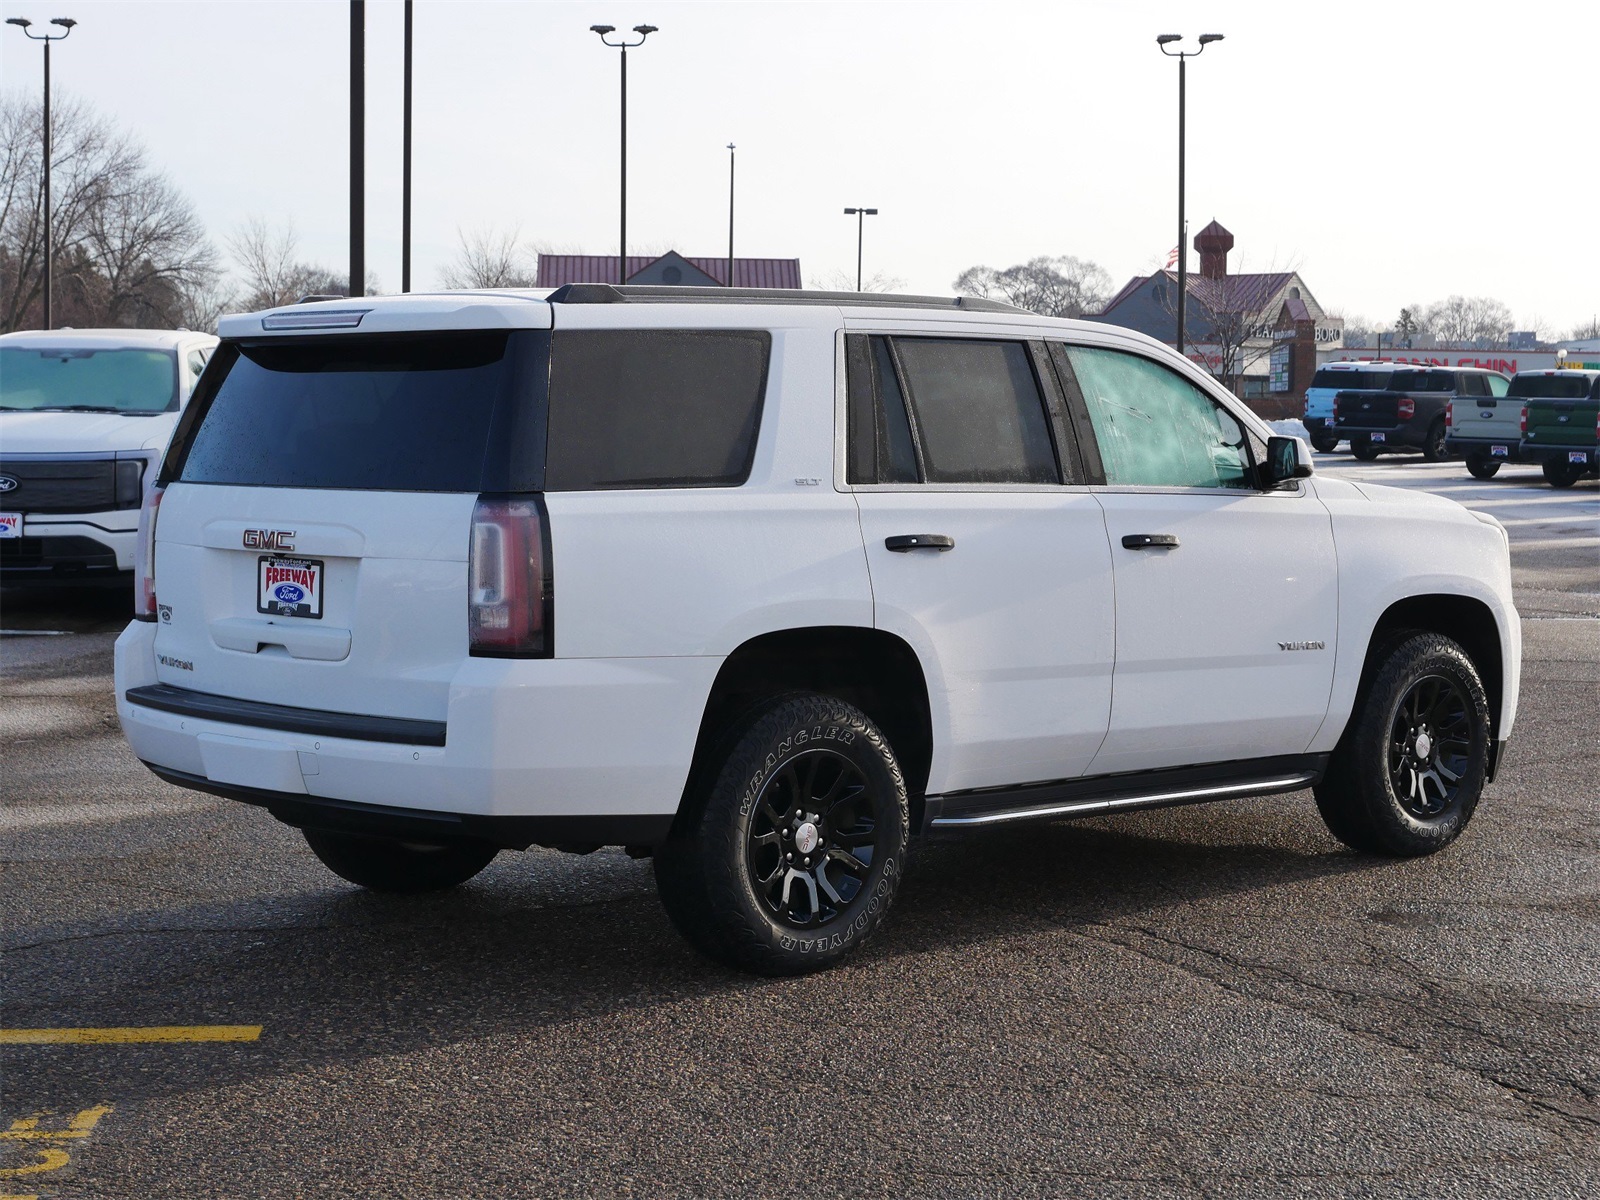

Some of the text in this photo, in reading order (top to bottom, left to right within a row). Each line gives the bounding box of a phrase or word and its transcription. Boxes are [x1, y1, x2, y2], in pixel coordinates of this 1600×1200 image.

[794, 478, 823, 486] SLT
[243, 529, 296, 551] GMC
[265, 566, 316, 597] FREEWAY
[280, 586, 300, 601] Ford
[1277, 640, 1326, 651] YUKON
[157, 654, 194, 671] YUKON
[739, 725, 856, 817] WRANGLER
[780, 857, 895, 954] GOODYEAR
